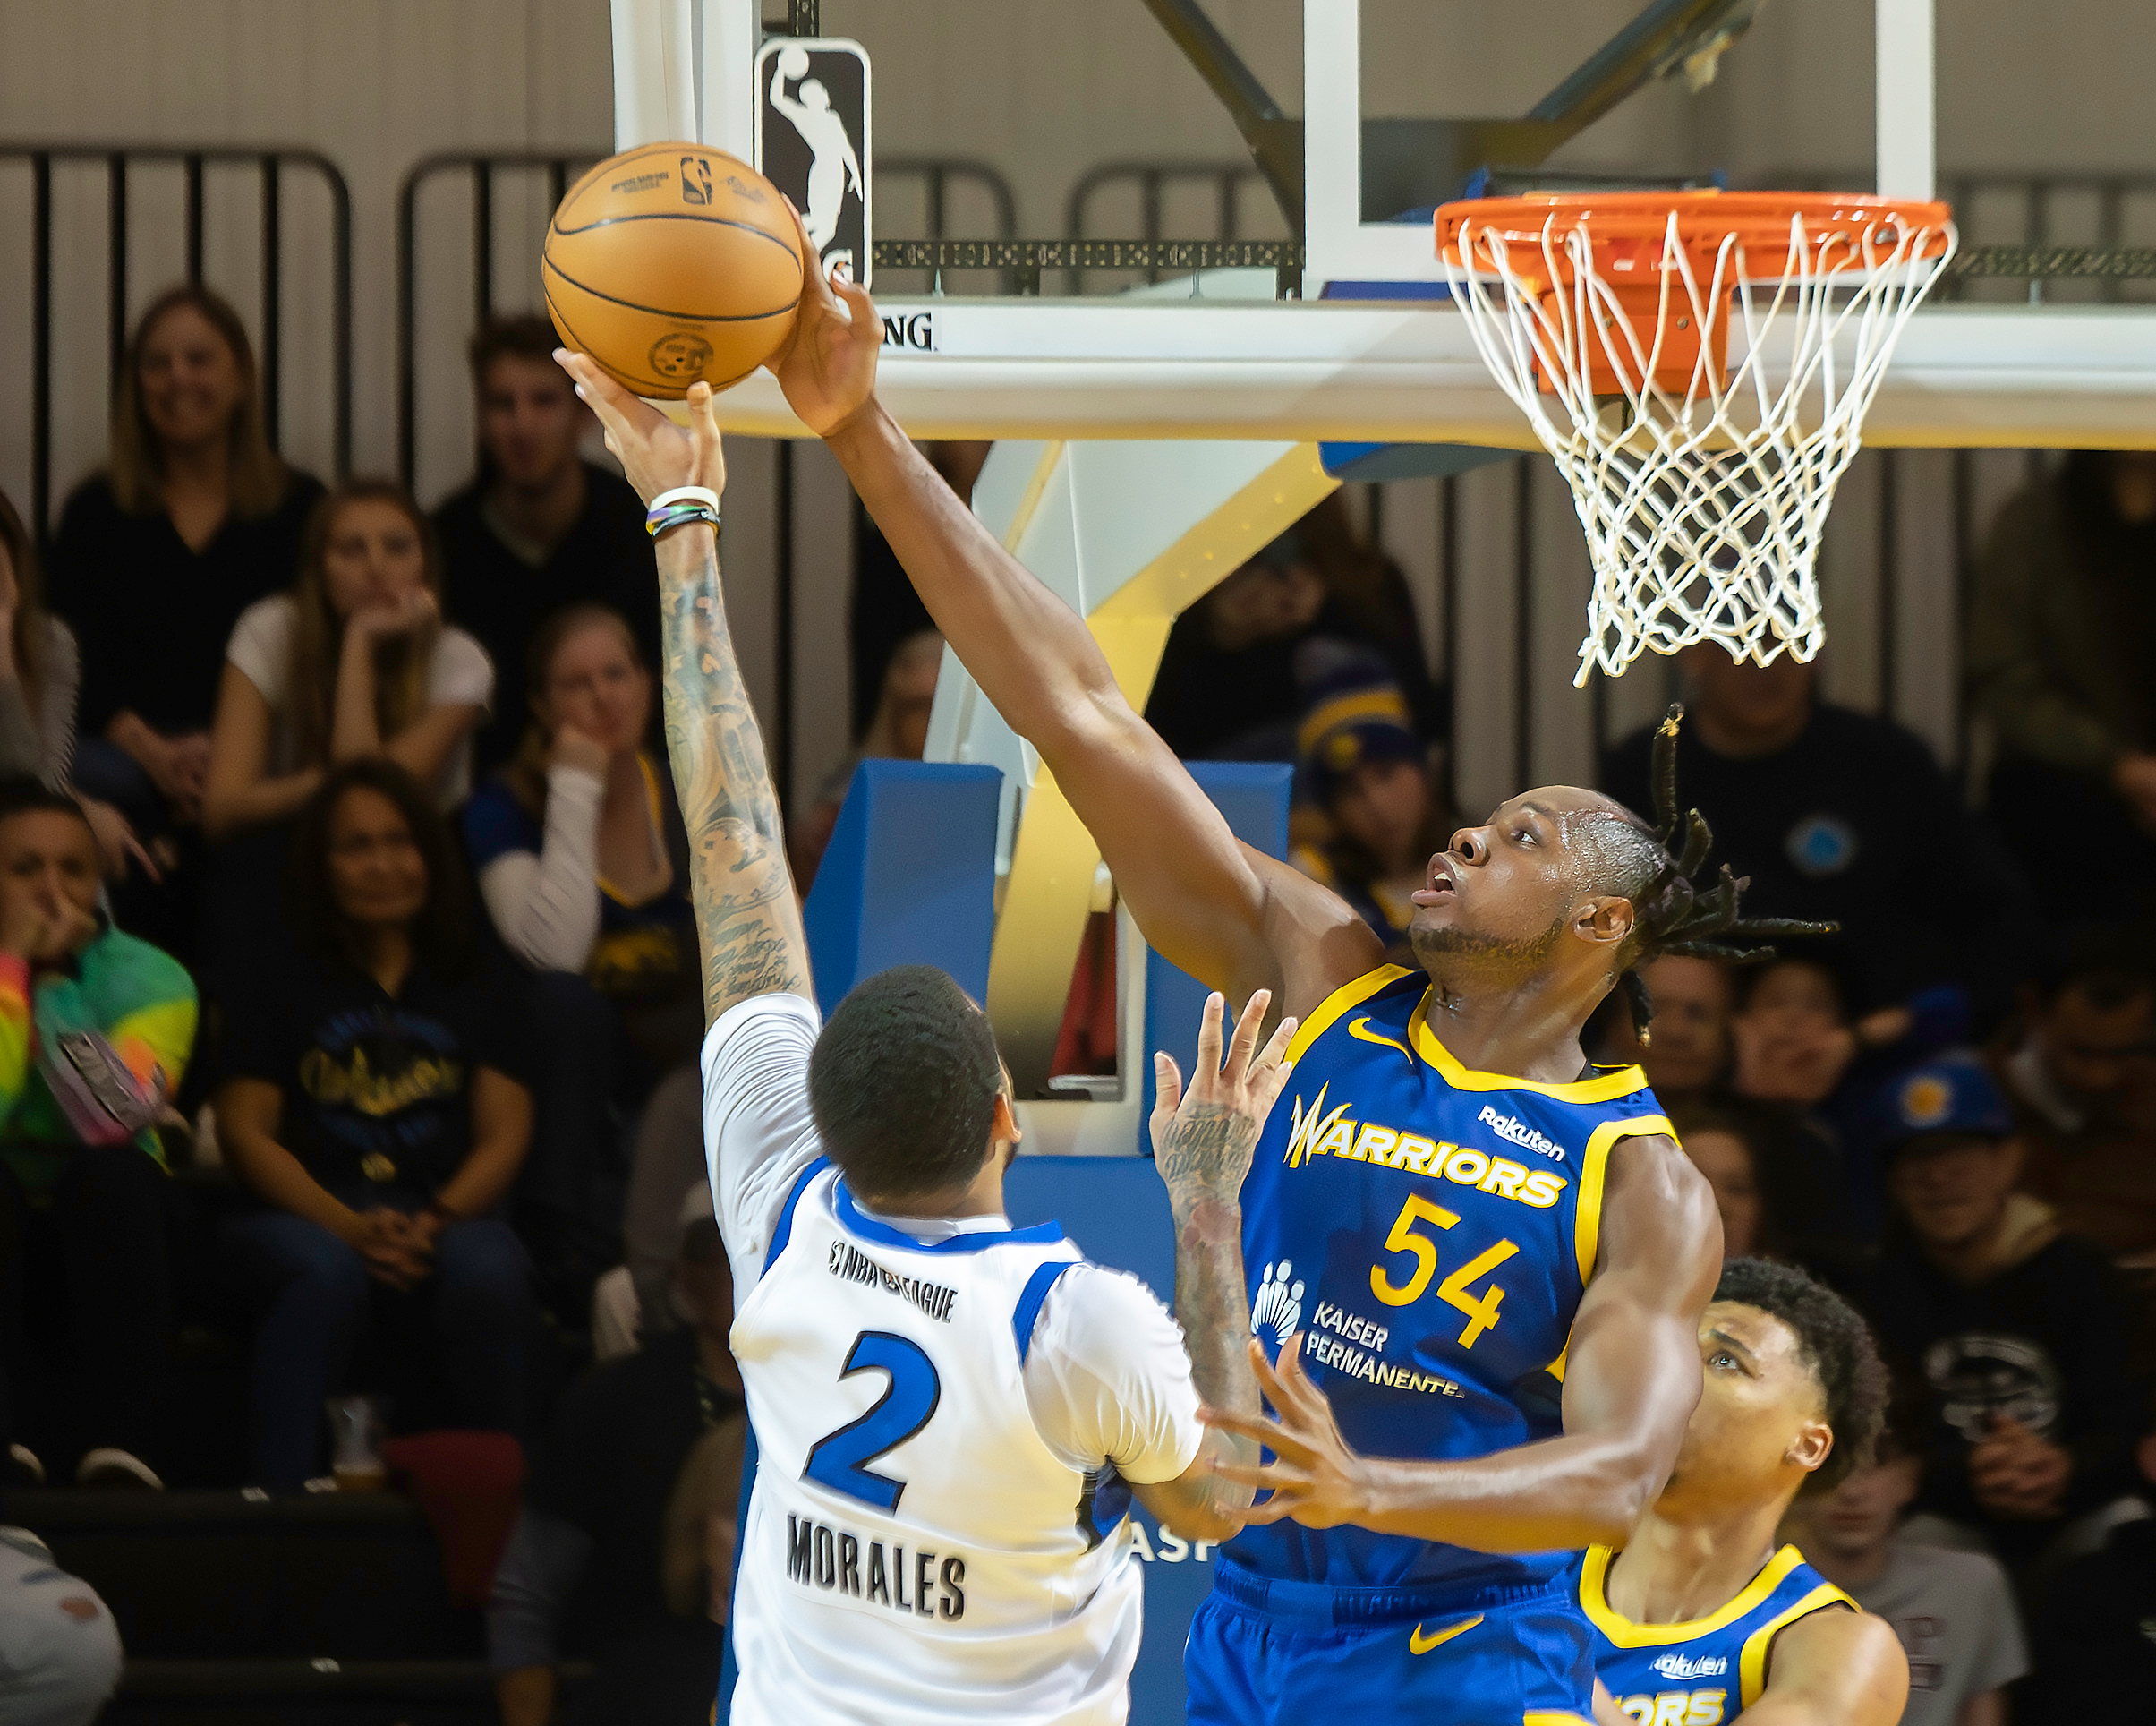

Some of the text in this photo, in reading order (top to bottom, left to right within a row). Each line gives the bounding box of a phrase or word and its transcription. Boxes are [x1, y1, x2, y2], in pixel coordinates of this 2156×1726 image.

[882, 312, 932, 352] NG
[1283, 1080, 1568, 1209] WARRIORS
[1477, 1105, 1566, 1163] Rakuten
[1369, 1192, 1521, 1350] 54
[1312, 1300, 1390, 1353] KAISER
[798, 1330, 941, 1517] 2
[786, 1510, 966, 1623] MORALES
[1615, 1688, 1726, 1726] ORS
